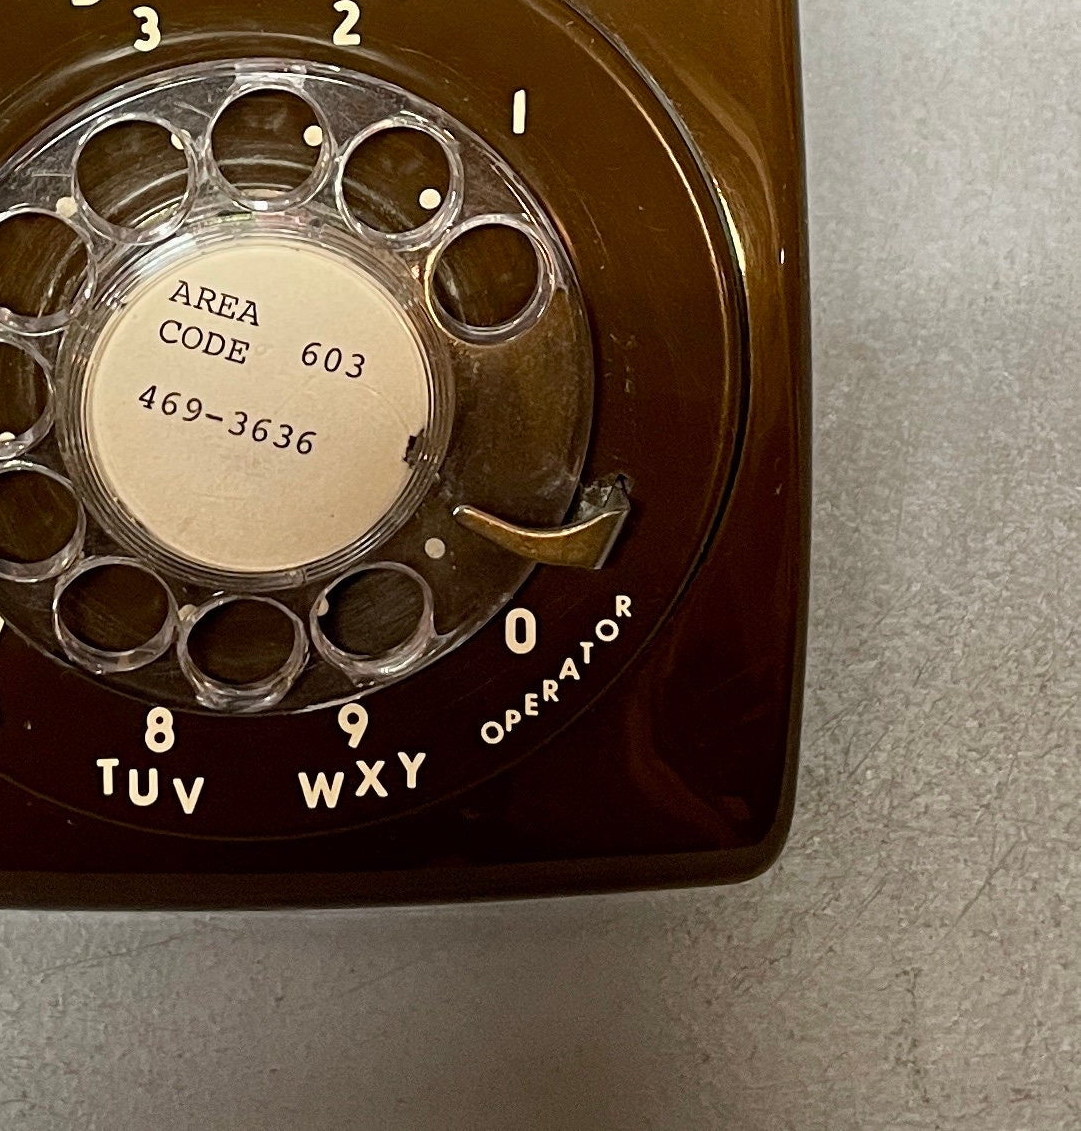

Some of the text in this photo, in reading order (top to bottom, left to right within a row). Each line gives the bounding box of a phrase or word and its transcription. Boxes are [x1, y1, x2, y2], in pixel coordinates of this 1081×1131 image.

[131, 6, 162, 52] 3
[327, 0, 361, 47] 2
[168, 279, 260, 327] AREA
[158, 319, 366, 379] CODE 603
[138, 385, 317, 455] 469-3636
[480, 594, 632, 745] OPERATOR
[144, 706, 175, 753] 8
[337, 704, 368, 749] 9
[96, 758, 205, 815] TUV
[297, 751, 427, 809] WXY
